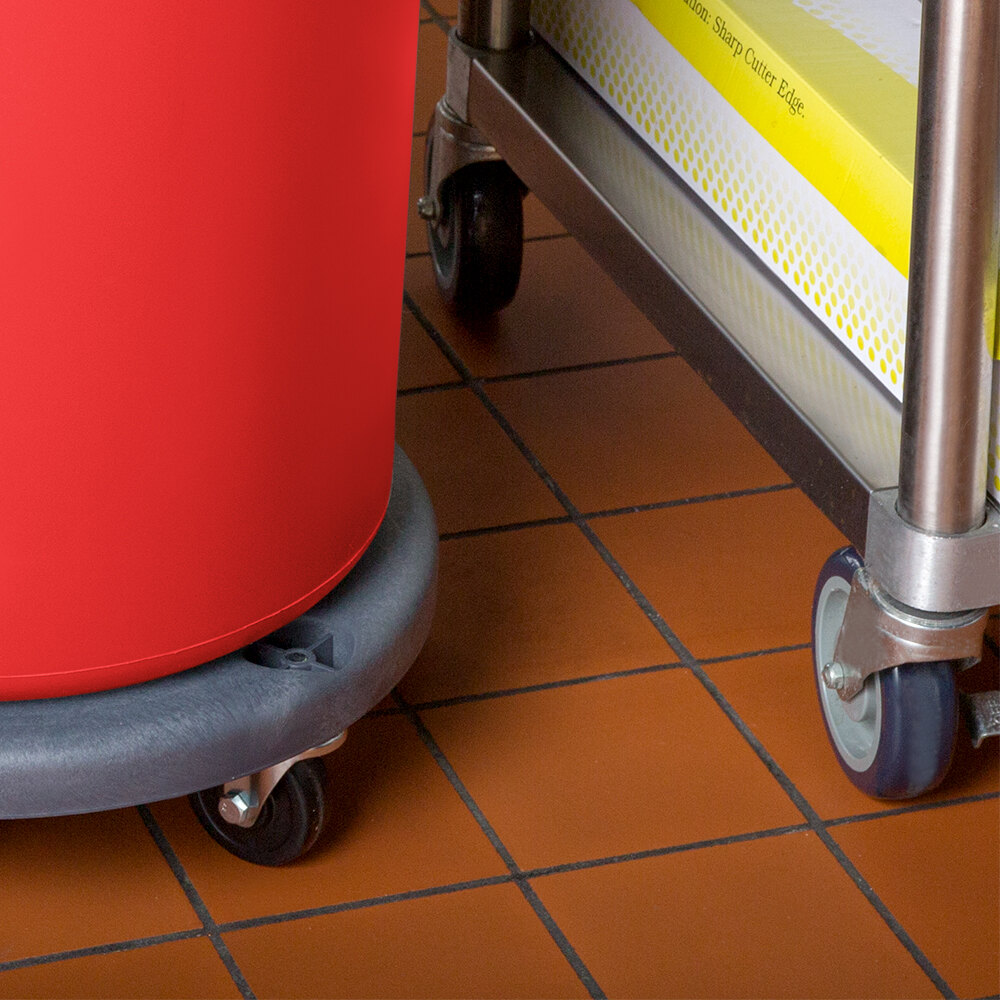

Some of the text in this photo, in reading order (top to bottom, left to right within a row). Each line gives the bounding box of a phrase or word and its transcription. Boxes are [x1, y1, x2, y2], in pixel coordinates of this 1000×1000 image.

[712, 15, 744, 58] Sharp
[744, 47, 777, 87] Cutter
[776, 78, 805, 118] Edge.
